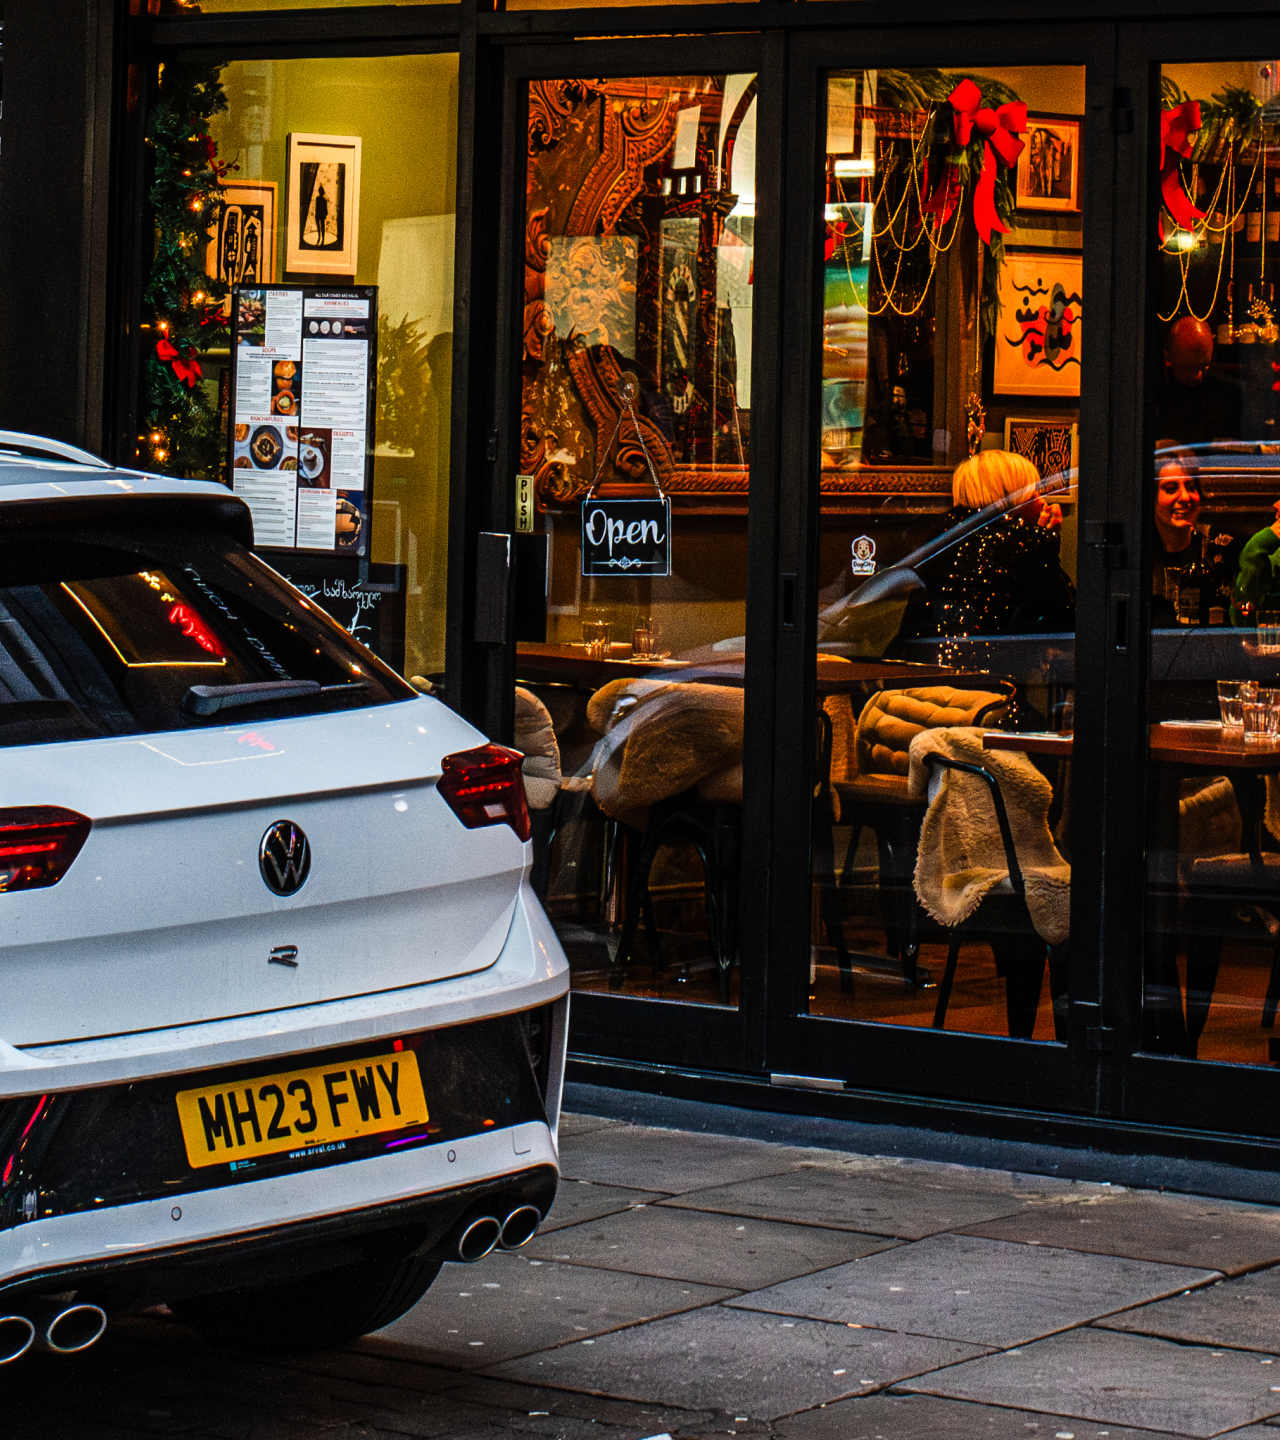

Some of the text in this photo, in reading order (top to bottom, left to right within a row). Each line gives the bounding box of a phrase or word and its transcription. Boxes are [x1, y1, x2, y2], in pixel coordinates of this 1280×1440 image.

[520, 478, 528, 530] PUSH
[585, 508, 666, 558] Open
[198, 1062, 402, 1151] MH23 FWY
